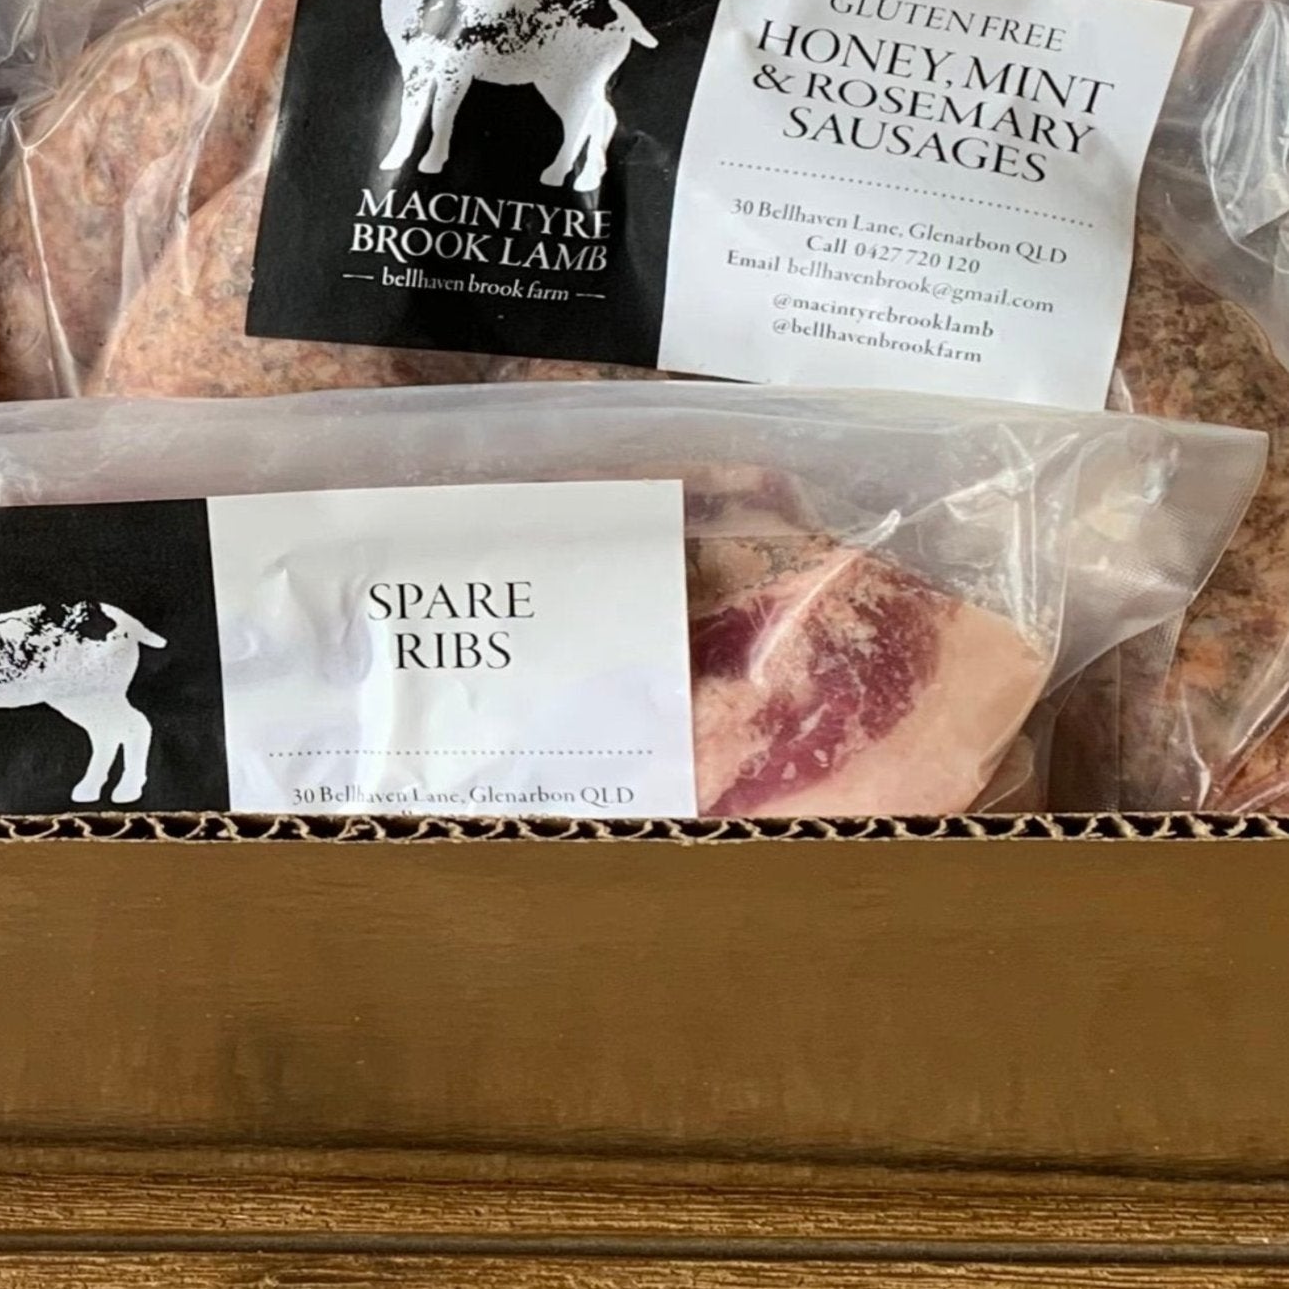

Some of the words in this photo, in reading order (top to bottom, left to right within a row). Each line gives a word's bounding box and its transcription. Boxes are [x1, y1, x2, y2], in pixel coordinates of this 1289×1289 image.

[980, 16, 1067, 53] FREE
[757, 19, 954, 89] HONEY,
[962, 55, 1115, 115] MINT
[752, 63, 791, 94] &
[806, 72, 1096, 155] ROSEMARY
[783, 106, 1047, 183] SAUSAGES
[356, 188, 611, 239] MACINTYRE
[730, 198, 754, 215] 30
[758, 201, 848, 229] Bellhaven
[853, 214, 904, 238] Lane,
[909, 223, 1010, 254] Glenarbon
[1016, 241, 1067, 264] QLD
[350, 223, 492, 263] BROOK
[498, 237, 607, 271] LAMB
[807, 235, 847, 255] Call
[382, 267, 464, 292] bellhaven
[468, 274, 524, 299] brook
[526, 282, 569, 301] farm
[727, 250, 780, 272] Email
[787, 257, 1054, 313] bellhavenbrook@gmail.com
[773, 293, 994, 338] @macintyrebrooklamb
[773, 317, 982, 363] @bellhavenbrookfarm
[368, 581, 534, 620] SPARE
[395, 631, 511, 670] RIBS
[293, 788, 314, 804] 30
[321, 786, 407, 803] Bellhaven
[413, 787, 465, 804] Lane,
[469, 785, 575, 803] Glenarbon
[581, 787, 634, 807] QLD
